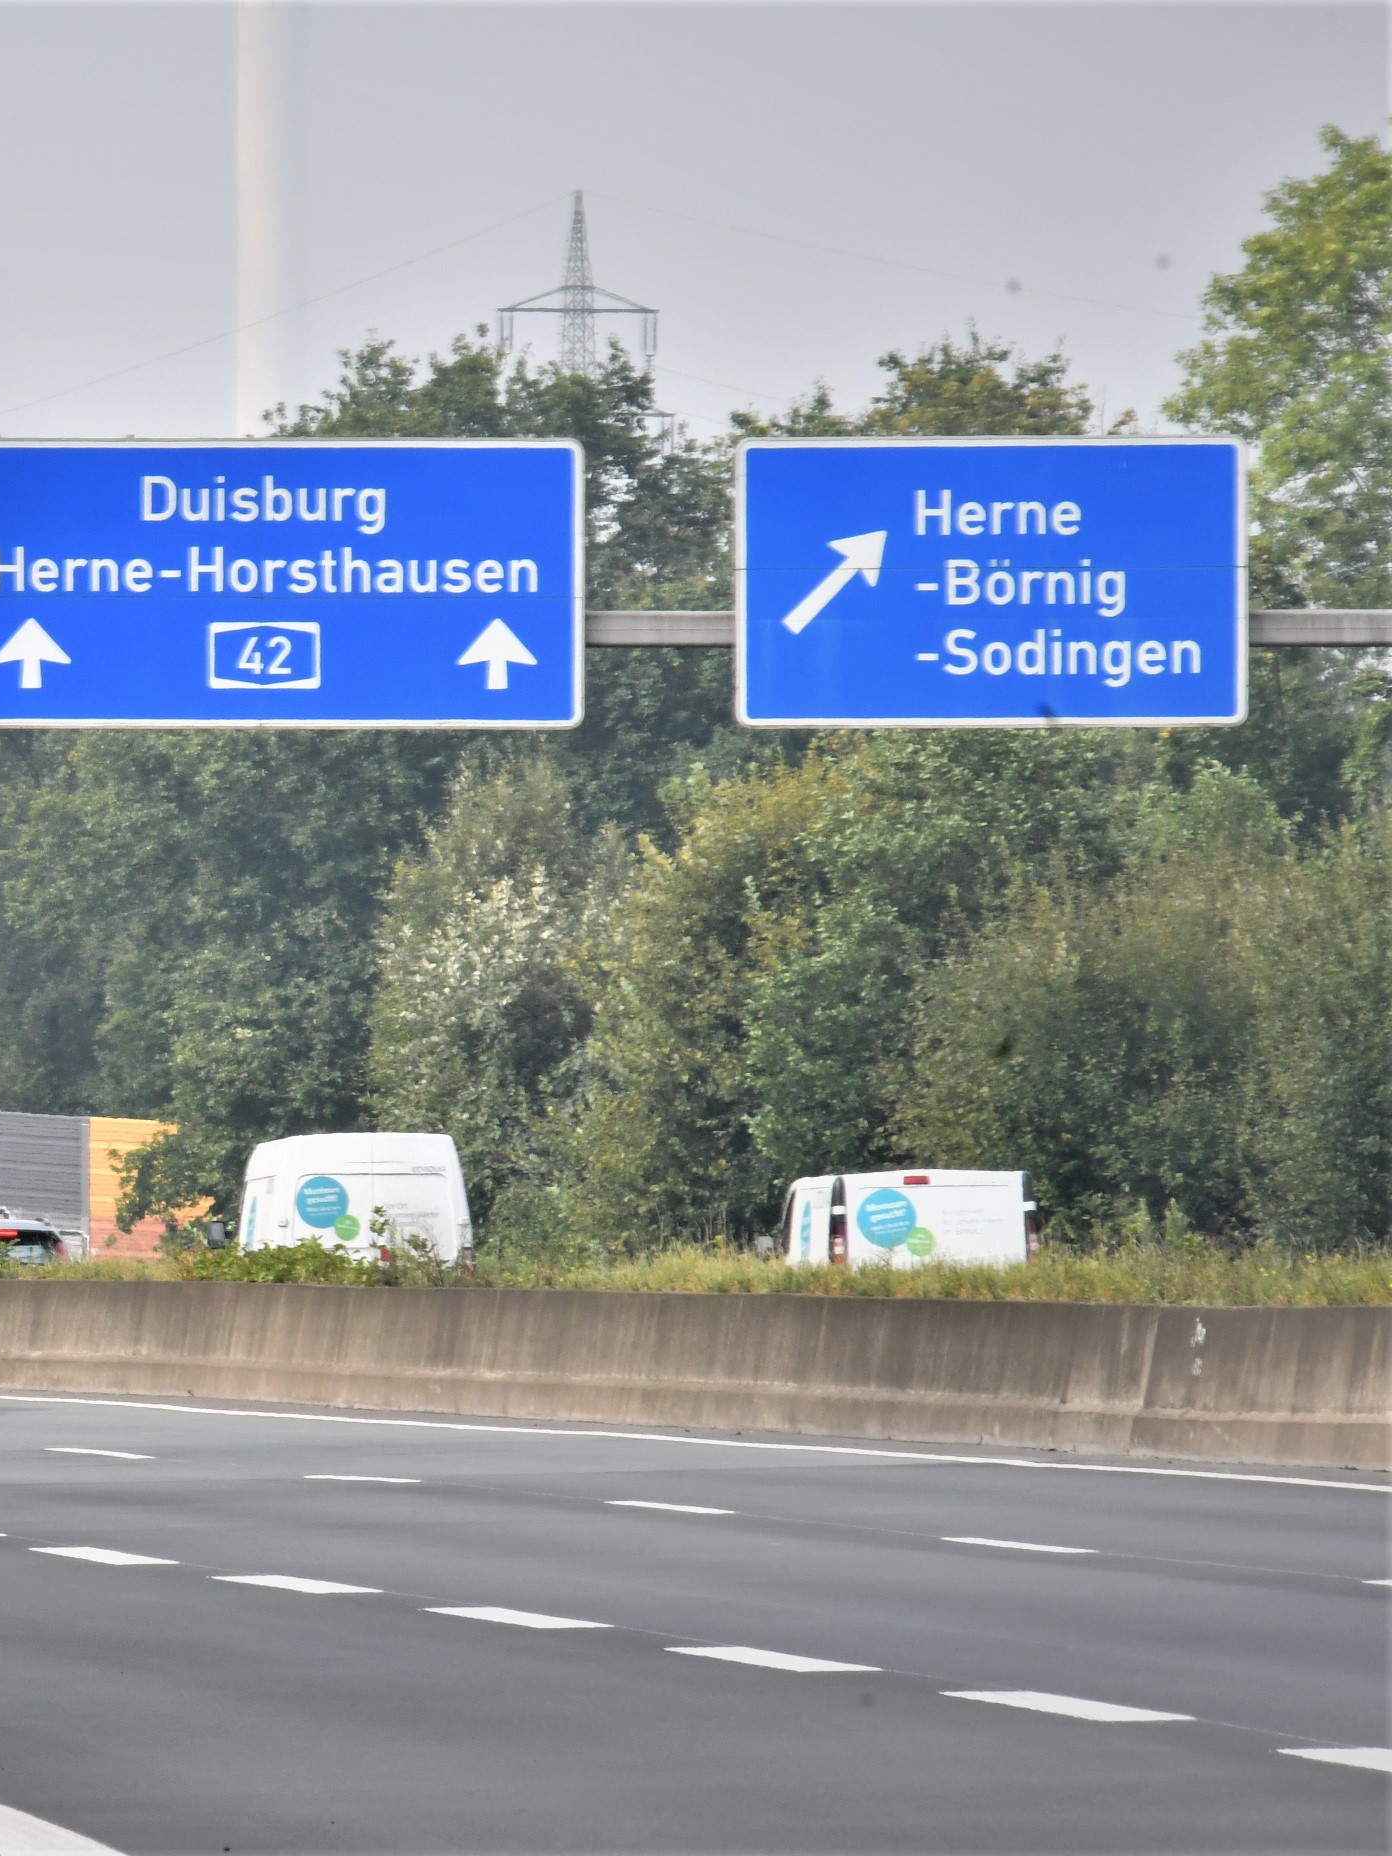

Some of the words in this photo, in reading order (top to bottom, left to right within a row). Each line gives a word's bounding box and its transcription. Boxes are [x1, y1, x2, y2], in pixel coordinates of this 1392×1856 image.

[140, 475, 386, 535] Duisburg
[914, 489, 1082, 536] Herne
[915, 559, 1127, 618] -Börnig
[236, 635, 293, 675] 42
[915, 628, 1202, 688] -Sodingen
